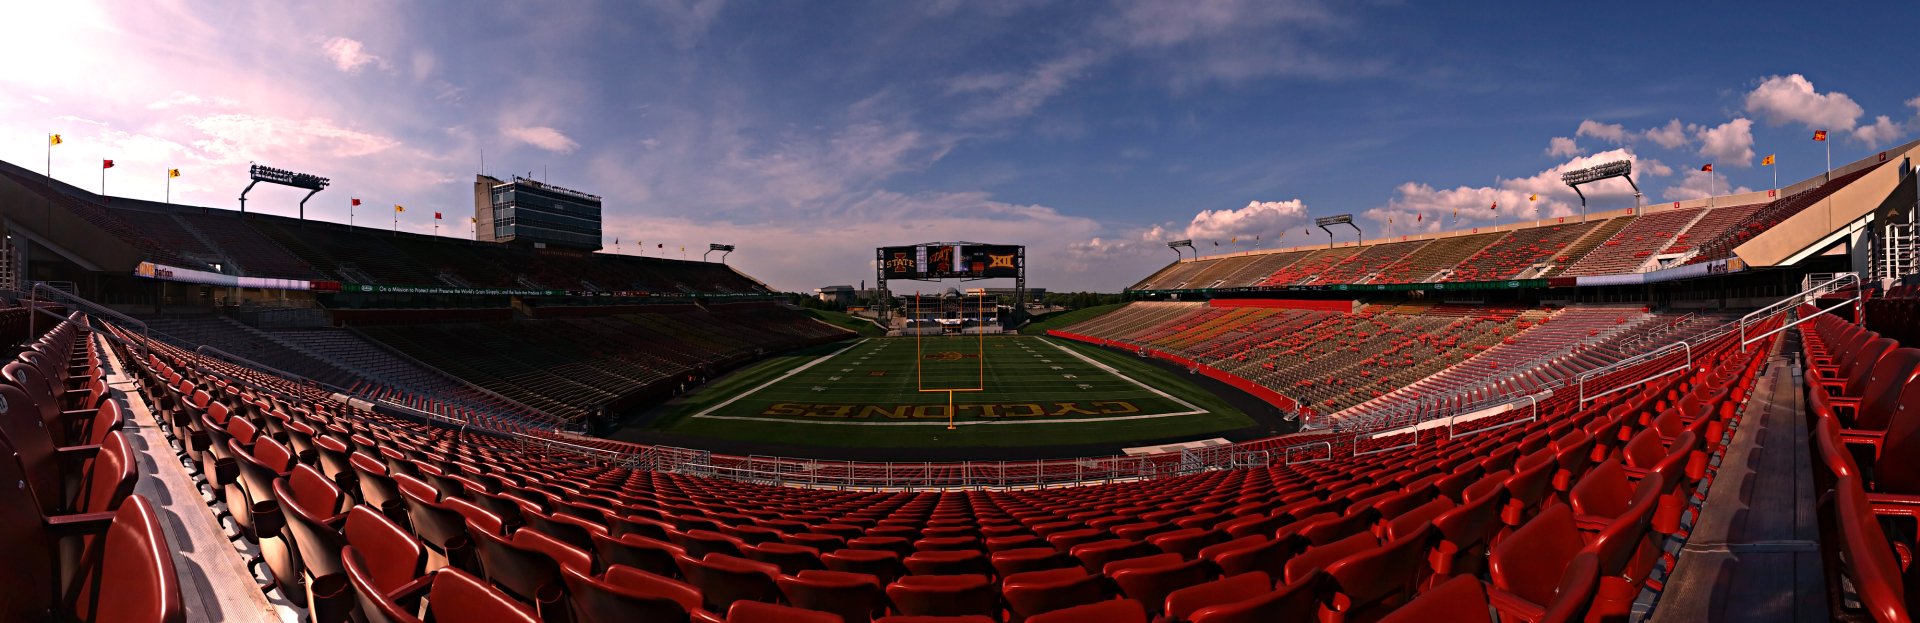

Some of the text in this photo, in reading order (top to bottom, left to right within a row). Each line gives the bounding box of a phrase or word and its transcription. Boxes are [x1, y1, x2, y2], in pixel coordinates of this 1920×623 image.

[886, 258, 915, 269] STATE
[988, 254, 1015, 268] XII
[761, 400, 1142, 419] CYCLONES
